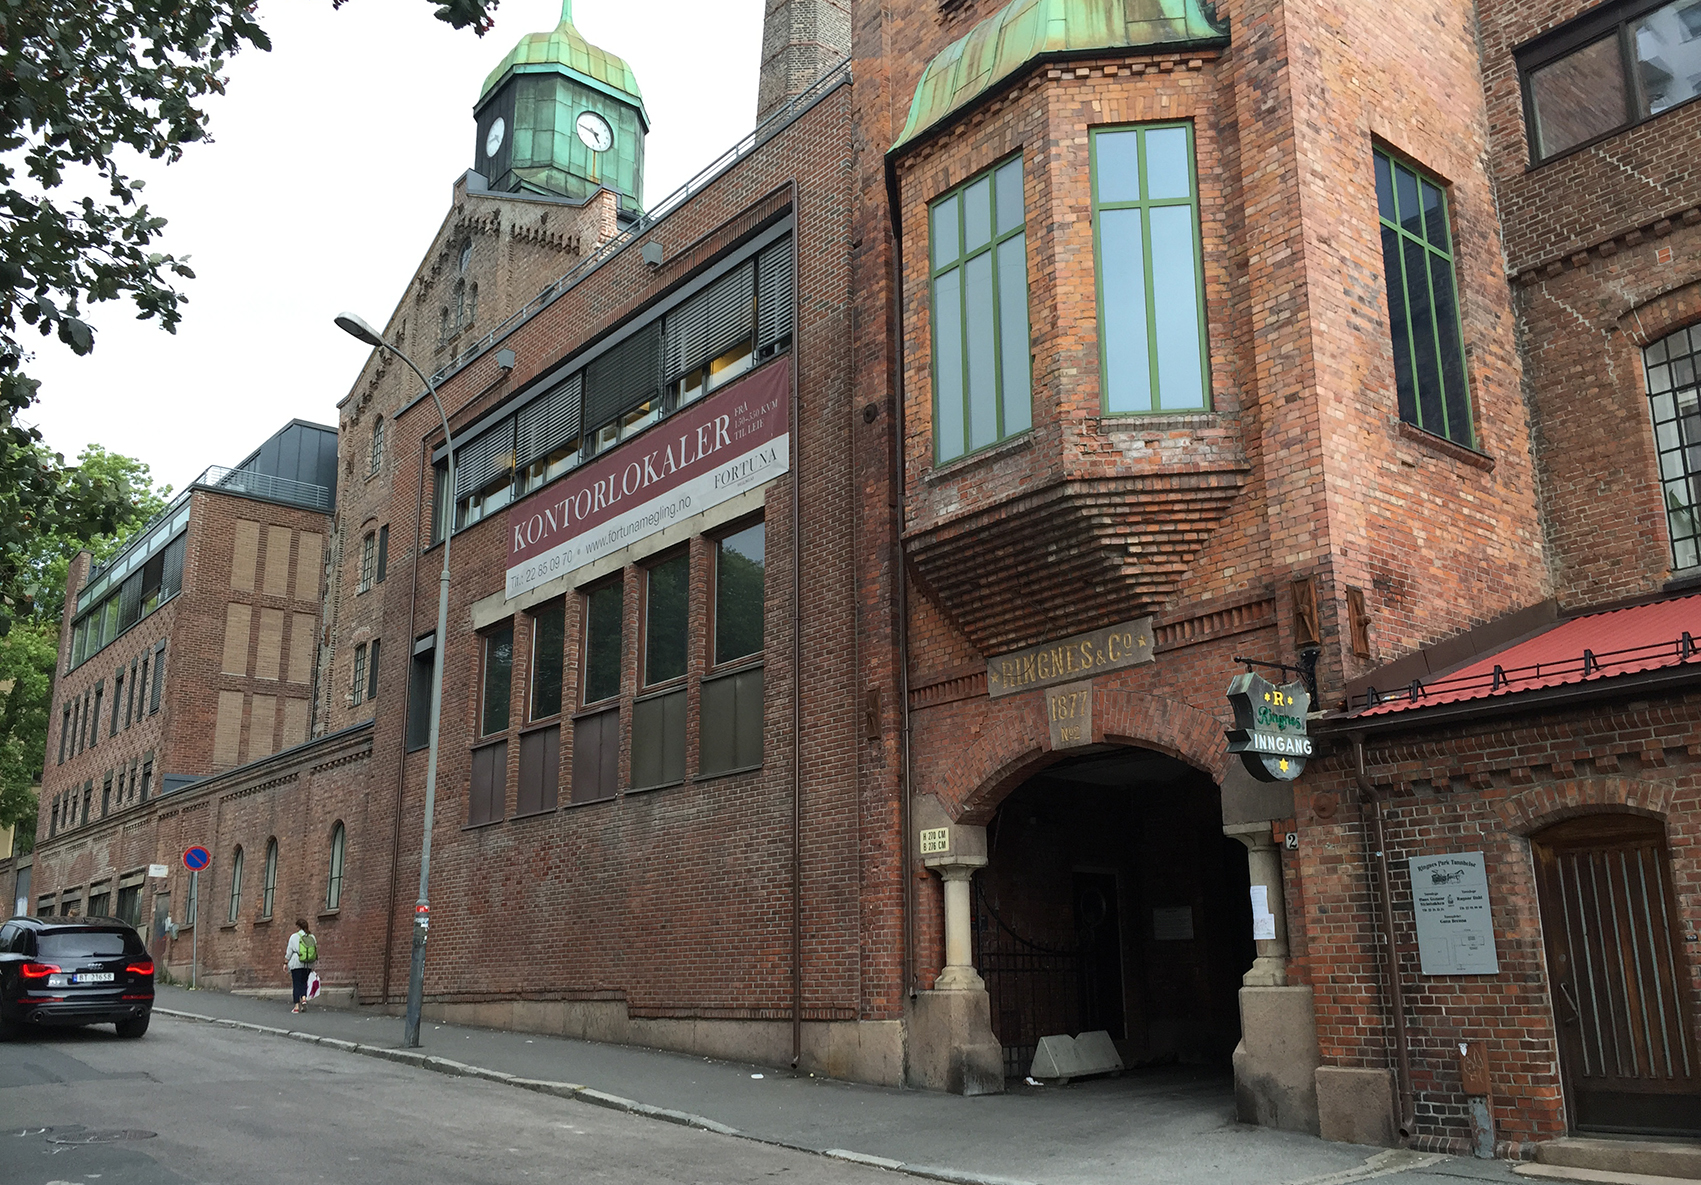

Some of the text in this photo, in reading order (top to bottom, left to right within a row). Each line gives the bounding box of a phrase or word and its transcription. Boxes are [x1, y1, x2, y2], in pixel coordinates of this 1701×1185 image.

[760, 398, 778, 415] KVM
[734, 418, 764, 440] TIL LEIE
[713, 447, 777, 490] FORTUNA
[513, 413, 731, 553] KONTORLOKALER
[526, 567, 536, 583] 22
[538, 561, 547, 577] 85
[549, 555, 560, 571] 09
[562, 550, 573, 566] 70
[585, 495, 692, 555] www.fortunamegling.no
[1001, 639, 1094, 689] RINGNES
[1051, 690, 1088, 721] 1877
[1272, 690, 1284, 706] R
[1257, 706, 1301, 730] Ringnes
[1254, 733, 1312, 755] INNGANG
[922, 830, 946, 841] H 270 CM
[922, 840, 946, 851] B 276 CM
[1287, 834, 1298, 849] 2
[1437, 860, 1449, 868] Park
